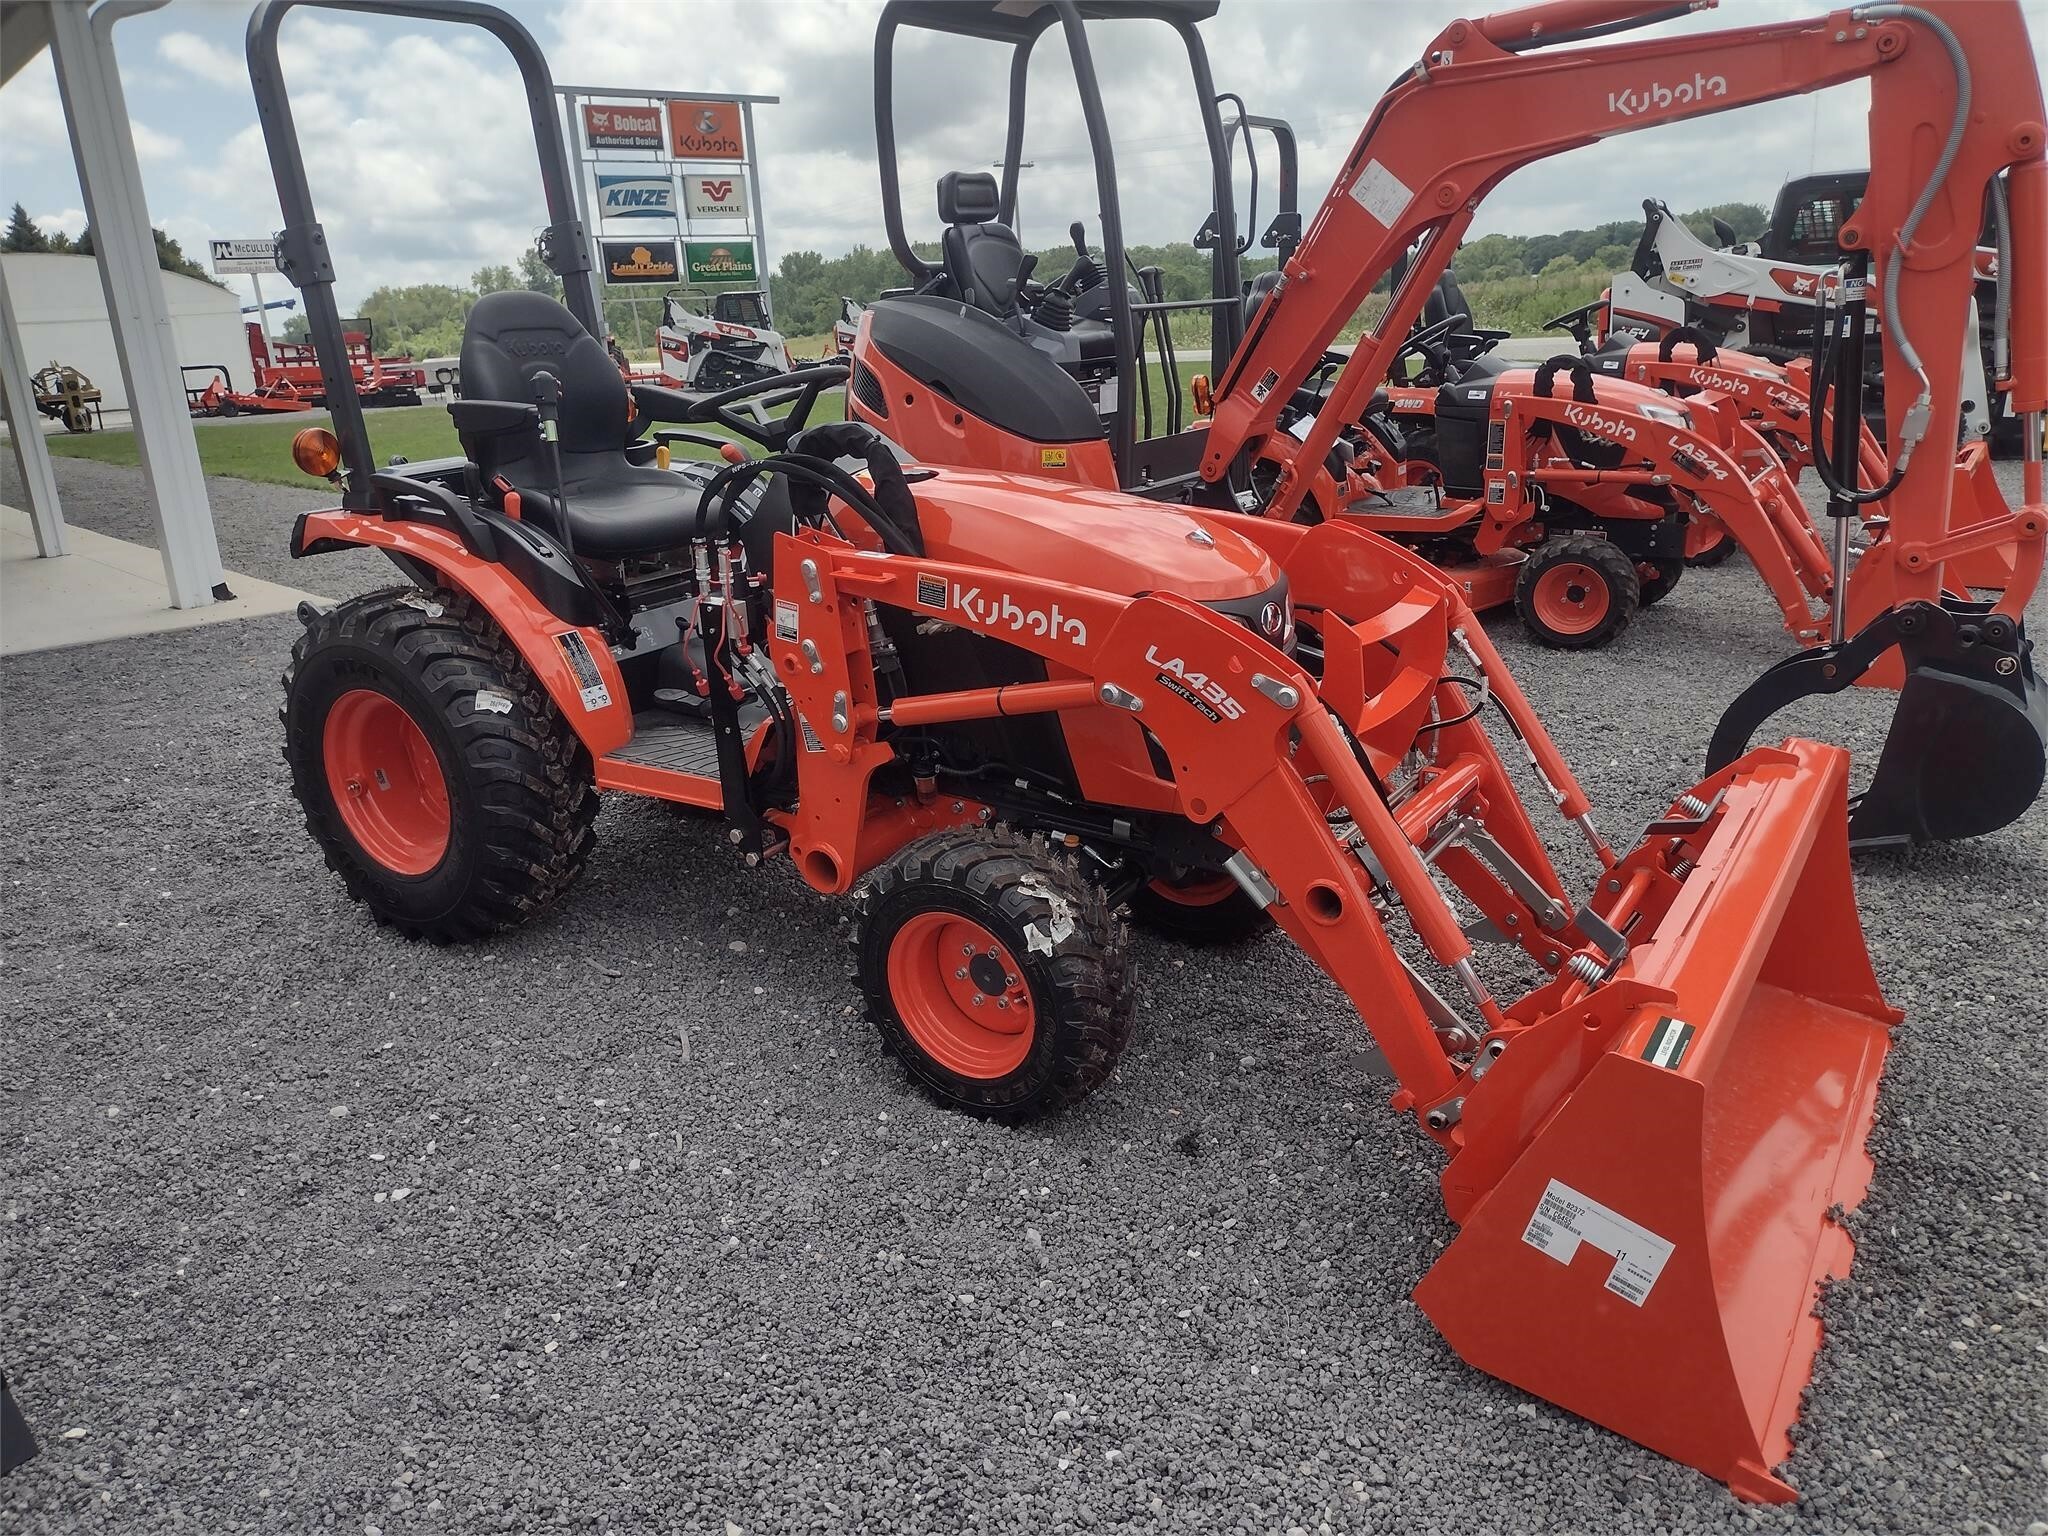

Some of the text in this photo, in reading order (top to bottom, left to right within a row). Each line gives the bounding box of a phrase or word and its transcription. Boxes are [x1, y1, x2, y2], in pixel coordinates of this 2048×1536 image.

[1608, 73, 1727, 116] Kubota
[613, 114, 657, 132] Bobcat
[596, 136, 658, 146] Authorized Dealer
[679, 135, 738, 152] Kubota
[606, 189, 670, 206] KINZE
[696, 205, 742, 213] VERSATILE
[647, 261, 674, 271] Pride
[692, 261, 753, 272] Great Plains
[1690, 368, 1750, 395] Kubota
[1395, 399, 1425, 409] 4WD
[1564, 403, 1637, 441] Kubota
[1668, 435, 1729, 480] LA344
[953, 583, 1087, 646] Kubota
[1145, 644, 1247, 720] LA435
[1159, 675, 1218, 721] Swift-Tach
[1538, 1203, 1551, 1214] S/N
[1546, 1191, 1586, 1217] Model B2372
[1615, 1249, 1627, 1262] 11
